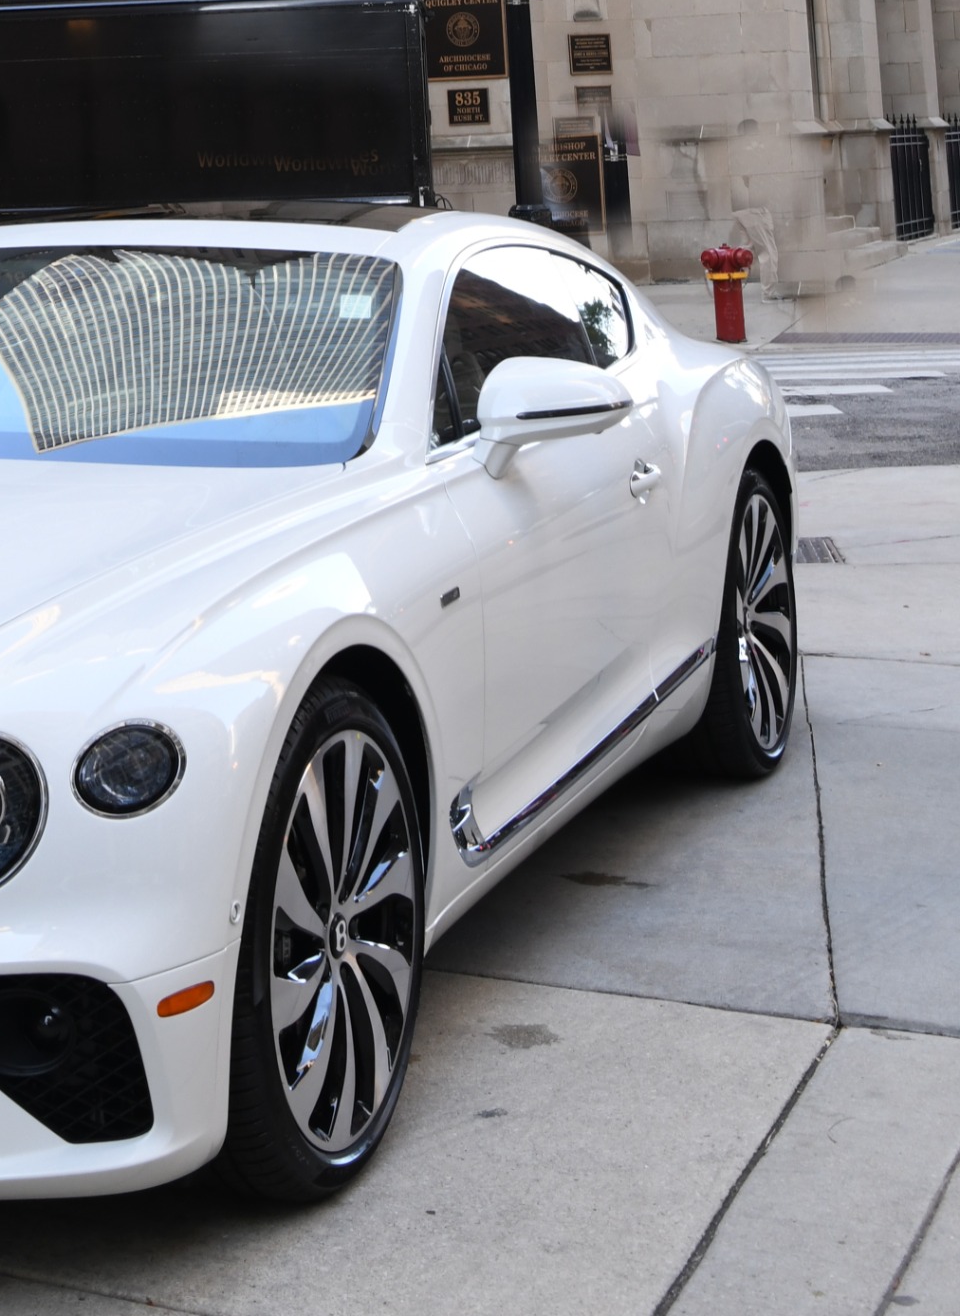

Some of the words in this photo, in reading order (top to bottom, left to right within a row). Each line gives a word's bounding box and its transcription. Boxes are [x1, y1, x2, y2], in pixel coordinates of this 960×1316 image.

[438, 53, 491, 64] ARCHDIOCESE
[443, 63, 453, 72] OF
[454, 62, 488, 72] CHICAGO
[454, 90, 481, 107] 835
[456, 106, 481, 115] NORTH
[561, 151, 596, 162] CENTER
